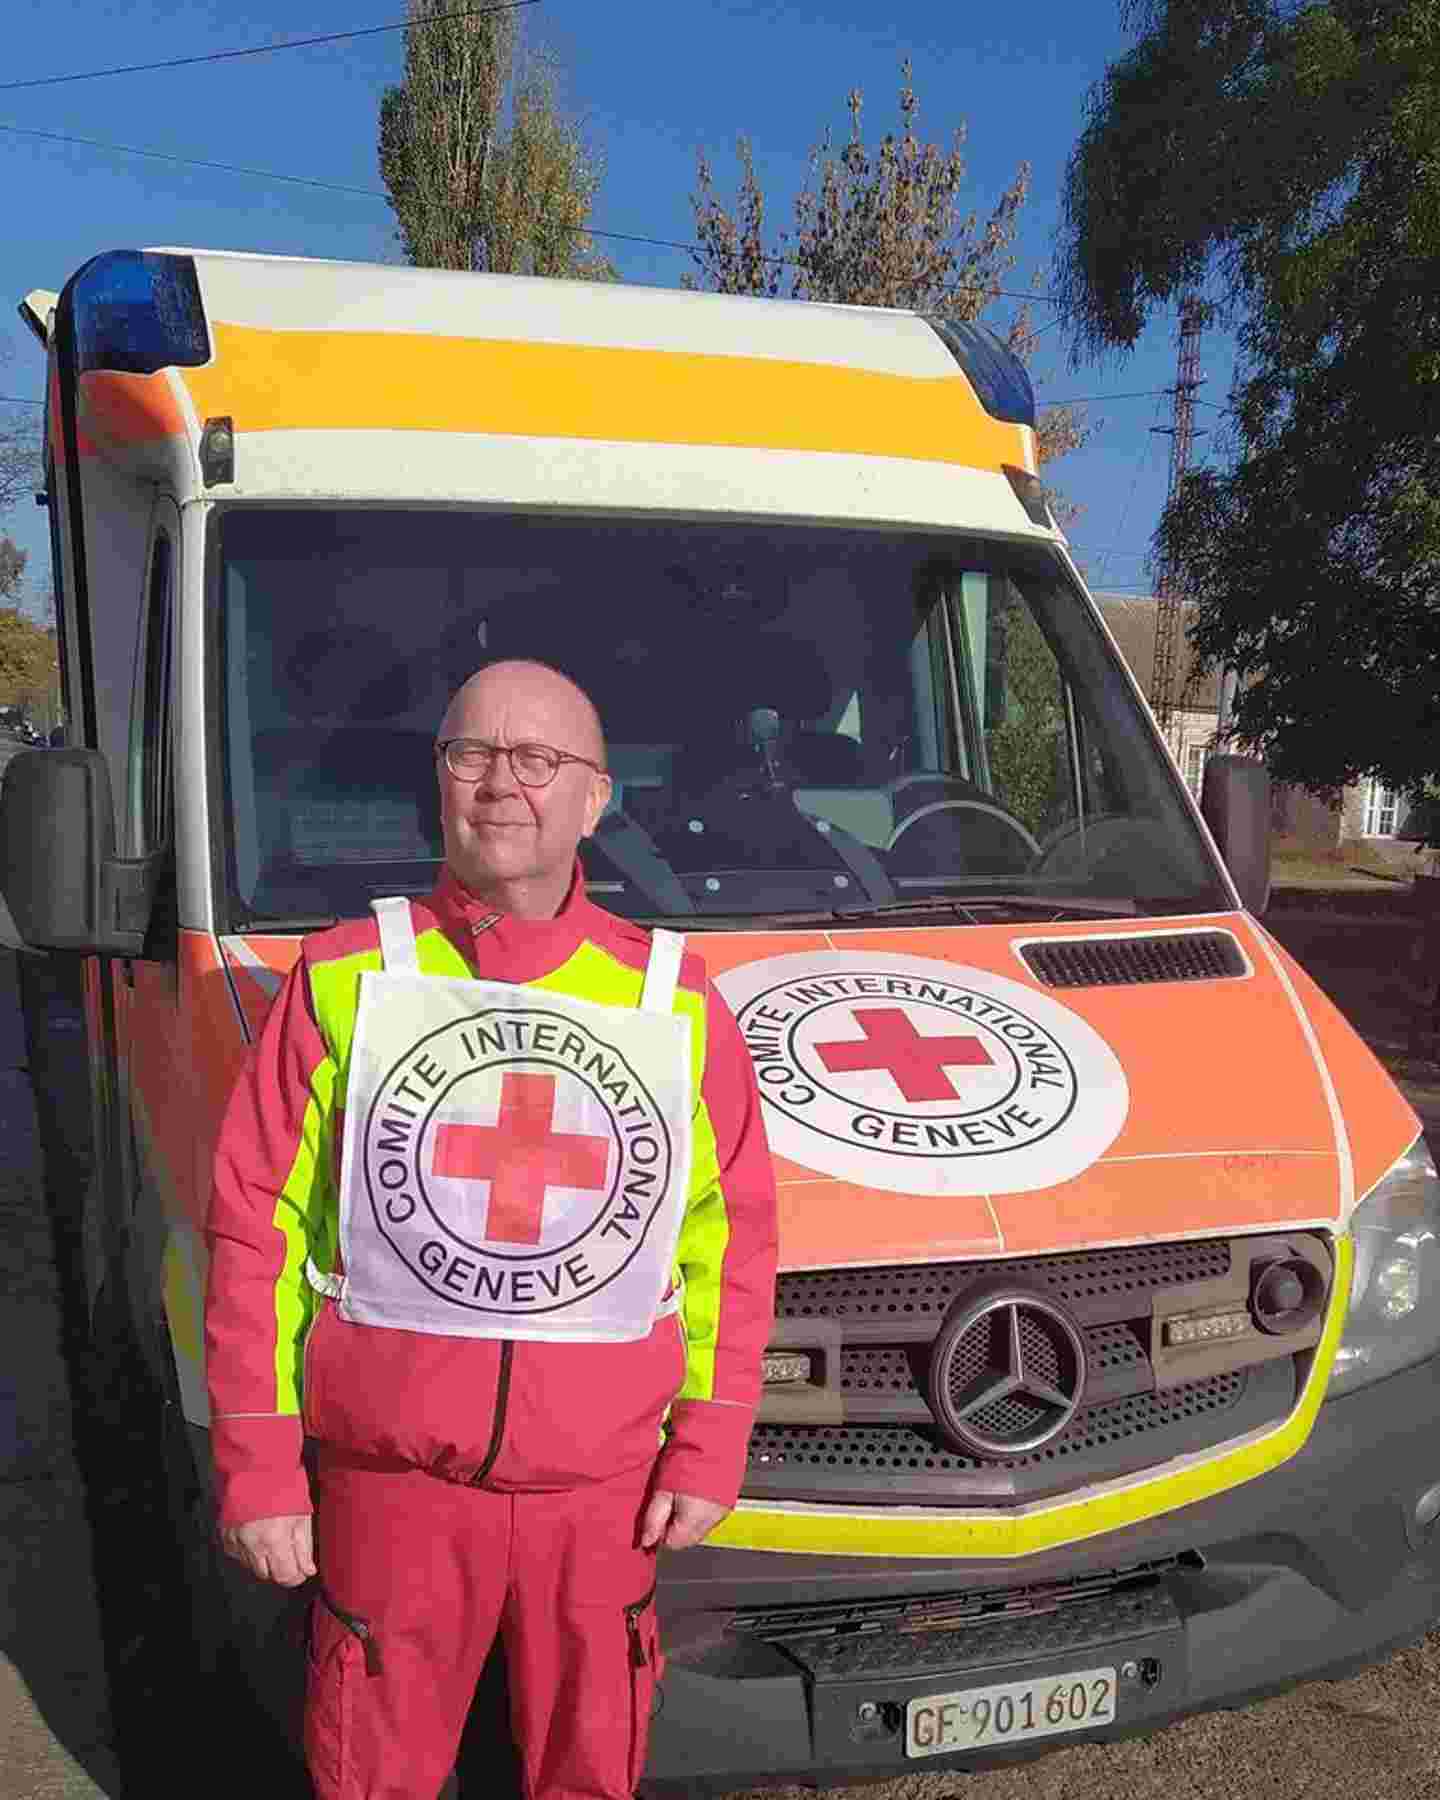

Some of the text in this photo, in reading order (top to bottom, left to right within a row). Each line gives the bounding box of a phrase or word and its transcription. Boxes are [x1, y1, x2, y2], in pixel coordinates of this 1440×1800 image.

[747, 977, 1064, 1105] COMITE INTERNATIONAL
[377, 1021, 659, 1241] COMITE INTERNATIONAL
[851, 1103, 1042, 1147] GENEVE
[418, 1240, 595, 1302] GENEVE
